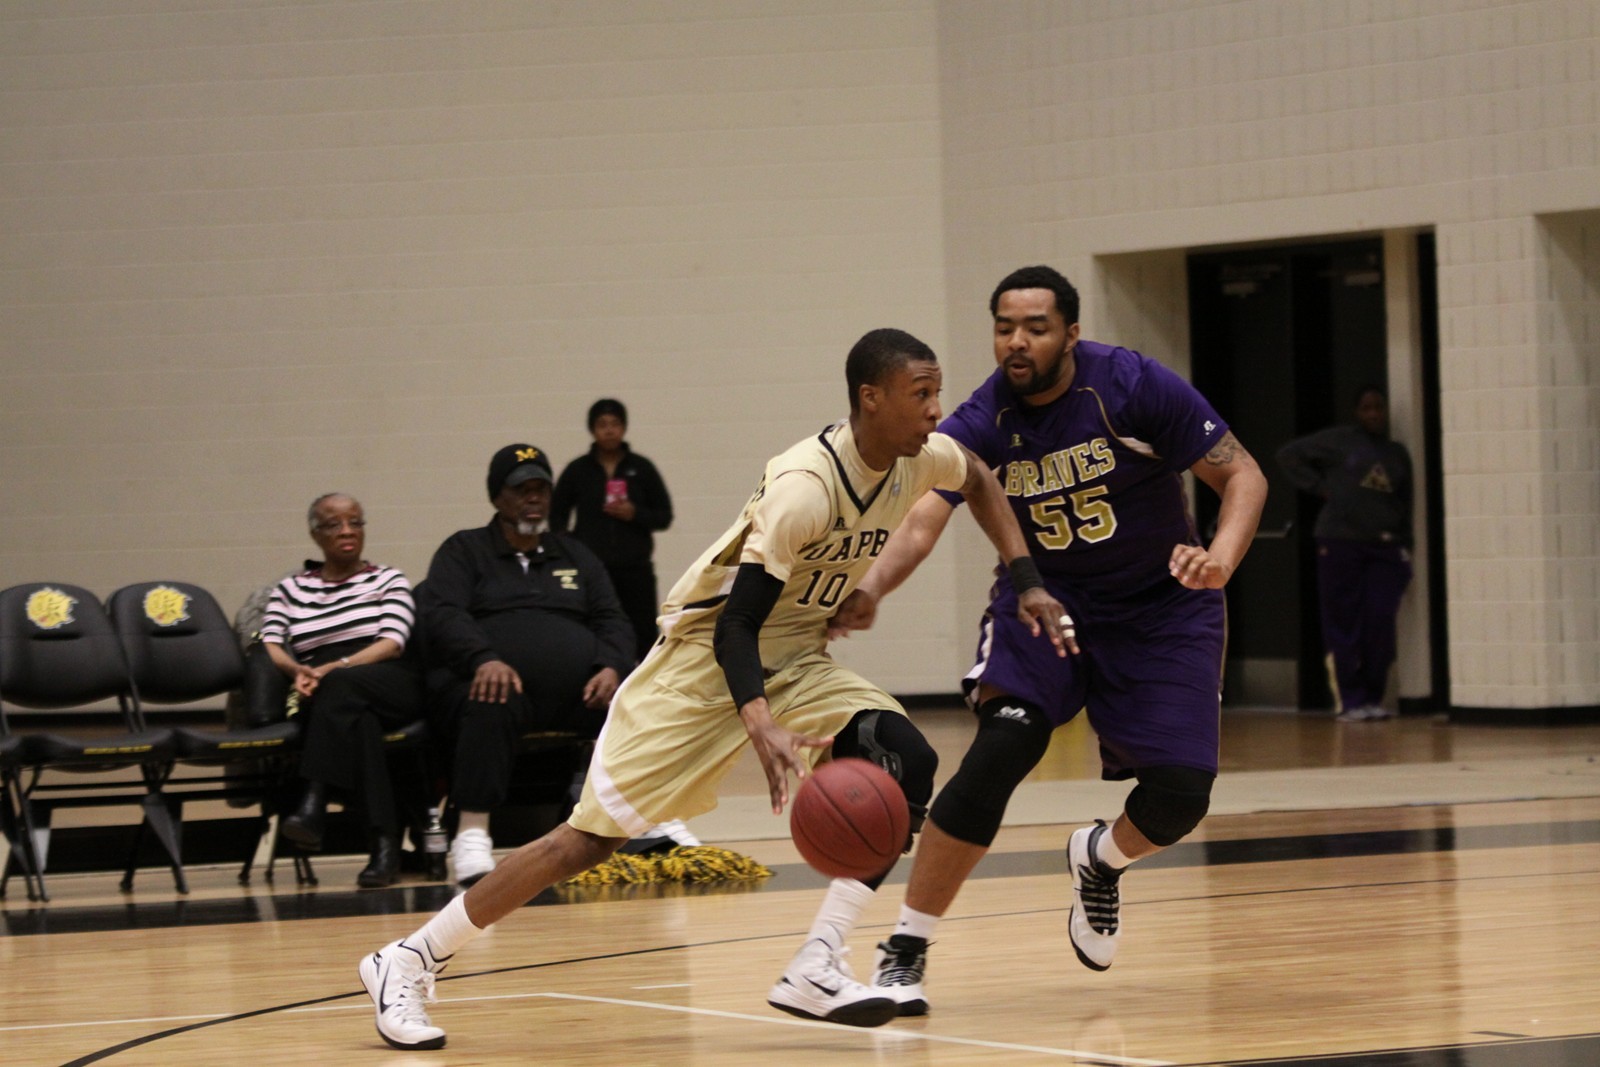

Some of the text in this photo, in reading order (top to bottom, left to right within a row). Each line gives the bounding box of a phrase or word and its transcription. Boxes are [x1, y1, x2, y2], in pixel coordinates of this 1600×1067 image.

[1005, 437, 1116, 498] BRAVES
[1029, 485, 1118, 550] 55
[802, 528, 889, 563] UAPB
[796, 569, 849, 609] 10
